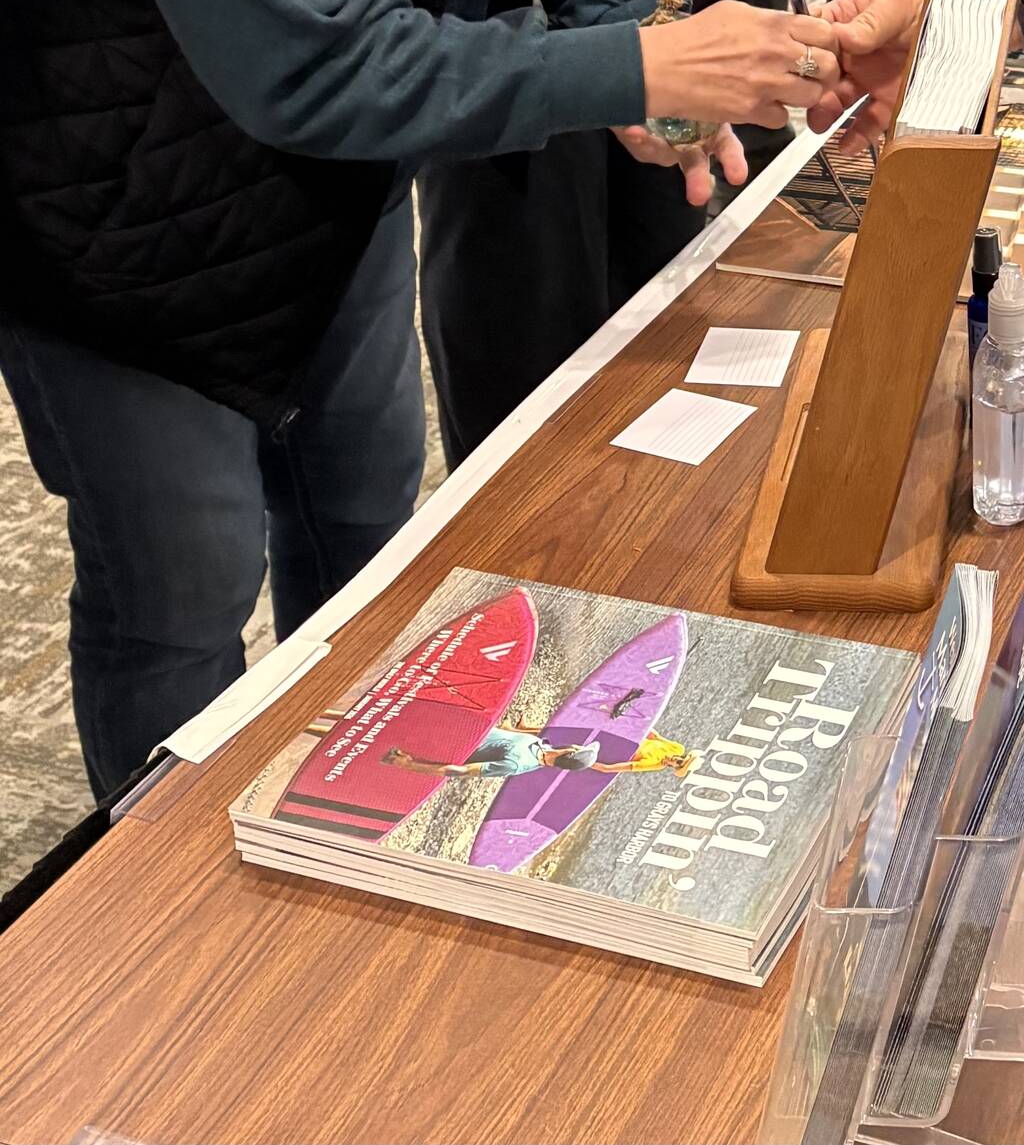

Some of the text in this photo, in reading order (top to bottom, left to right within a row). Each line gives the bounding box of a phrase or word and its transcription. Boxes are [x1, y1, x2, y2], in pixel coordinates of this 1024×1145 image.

[416, 629, 453, 664] Where
[441, 613, 485, 662] Schedule
[404, 664, 422, 677] to
[427, 662, 442, 675] of
[363, 698, 392, 725] What
[383, 675, 433, 721] Festivals
[346, 725, 363, 737] to
[361, 720, 387, 746] and
[325, 737, 347, 757] See
[325, 742, 369, 782] Events
[704, 698, 859, 858] Road
[616, 791, 680, 864] TO GRAYS HARBOR
